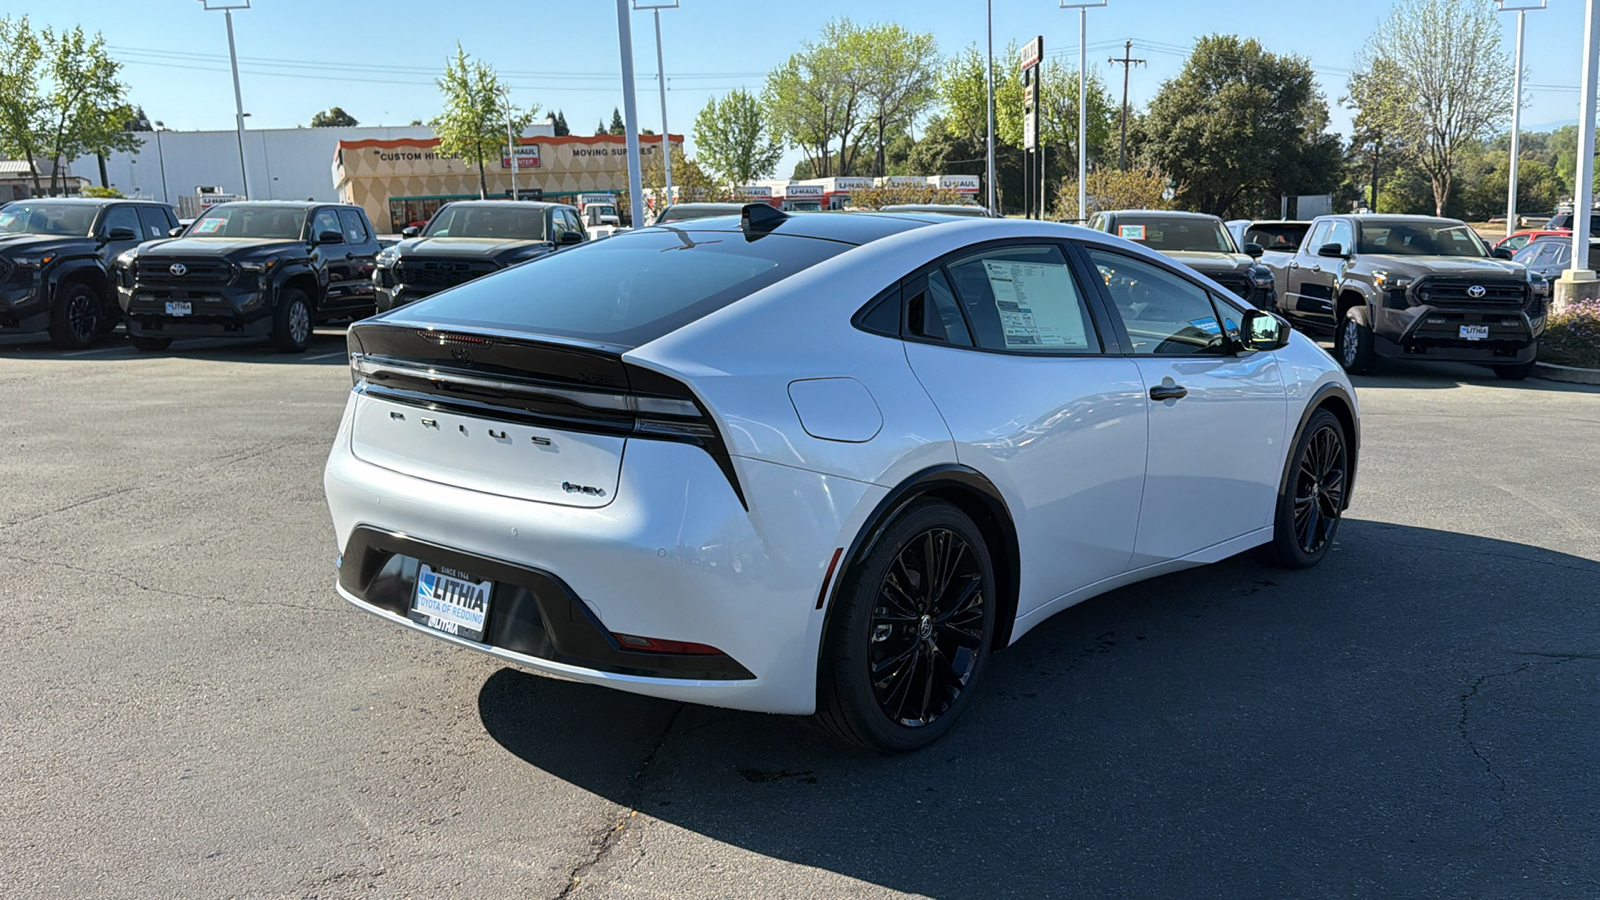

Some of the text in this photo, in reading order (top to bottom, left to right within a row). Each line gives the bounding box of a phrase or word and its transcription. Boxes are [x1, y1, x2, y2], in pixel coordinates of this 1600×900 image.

[380, 153, 421, 161] CUSTOM
[572, 148, 653, 157] MOVING SUPIES
[390, 411, 551, 446] PRIUS
[441, 566, 456, 576] SINCE
[433, 577, 484, 612] LITHIA
[418, 596, 483, 624] TOYOTA OF REDDING
[436, 618, 458, 634] LITHIA
